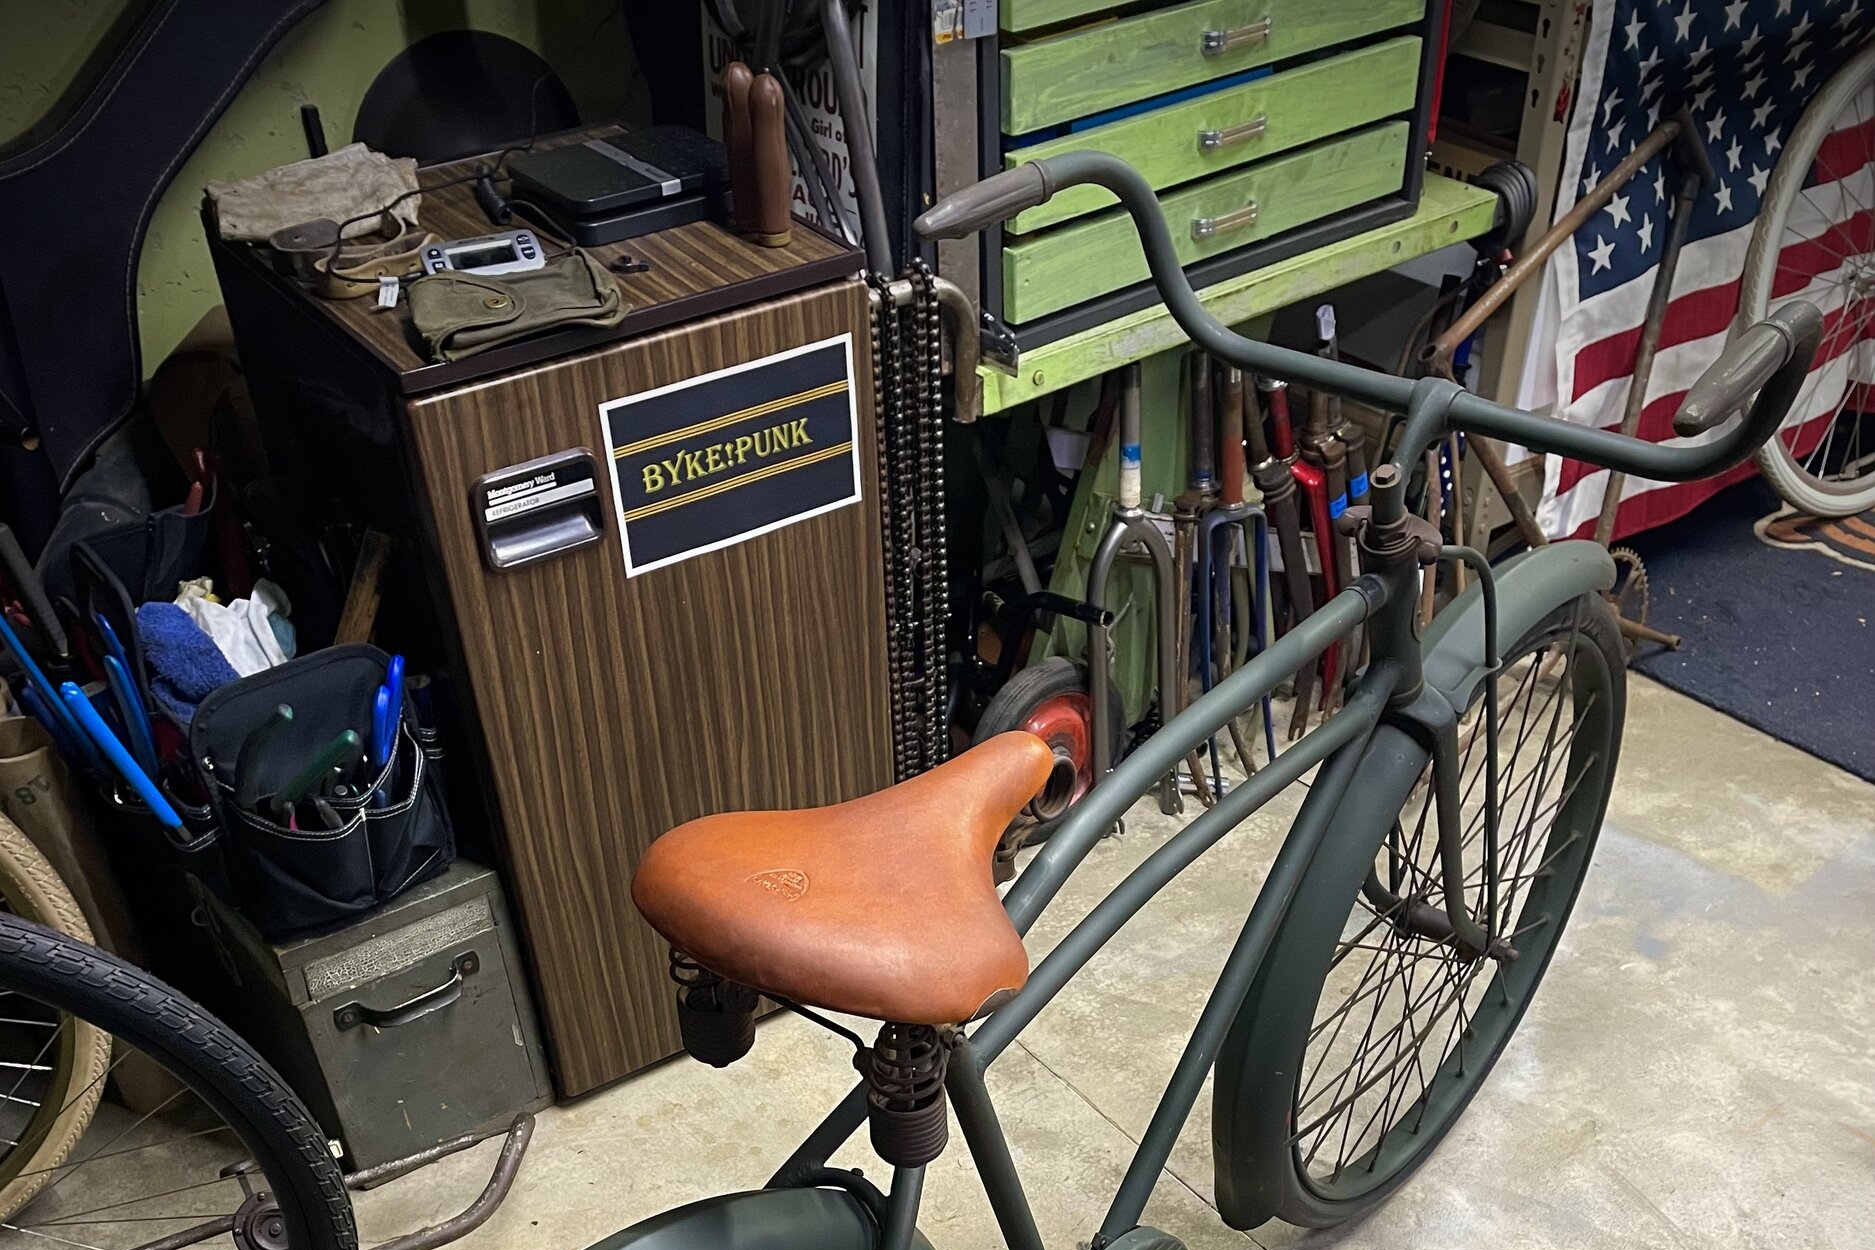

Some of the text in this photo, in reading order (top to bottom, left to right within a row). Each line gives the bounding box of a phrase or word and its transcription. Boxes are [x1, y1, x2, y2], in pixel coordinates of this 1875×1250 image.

[811, 117, 832, 139] Girl
[487, 471, 556, 500] Montgomery Ward
[491, 497, 540, 517] REFRIGERATOR
